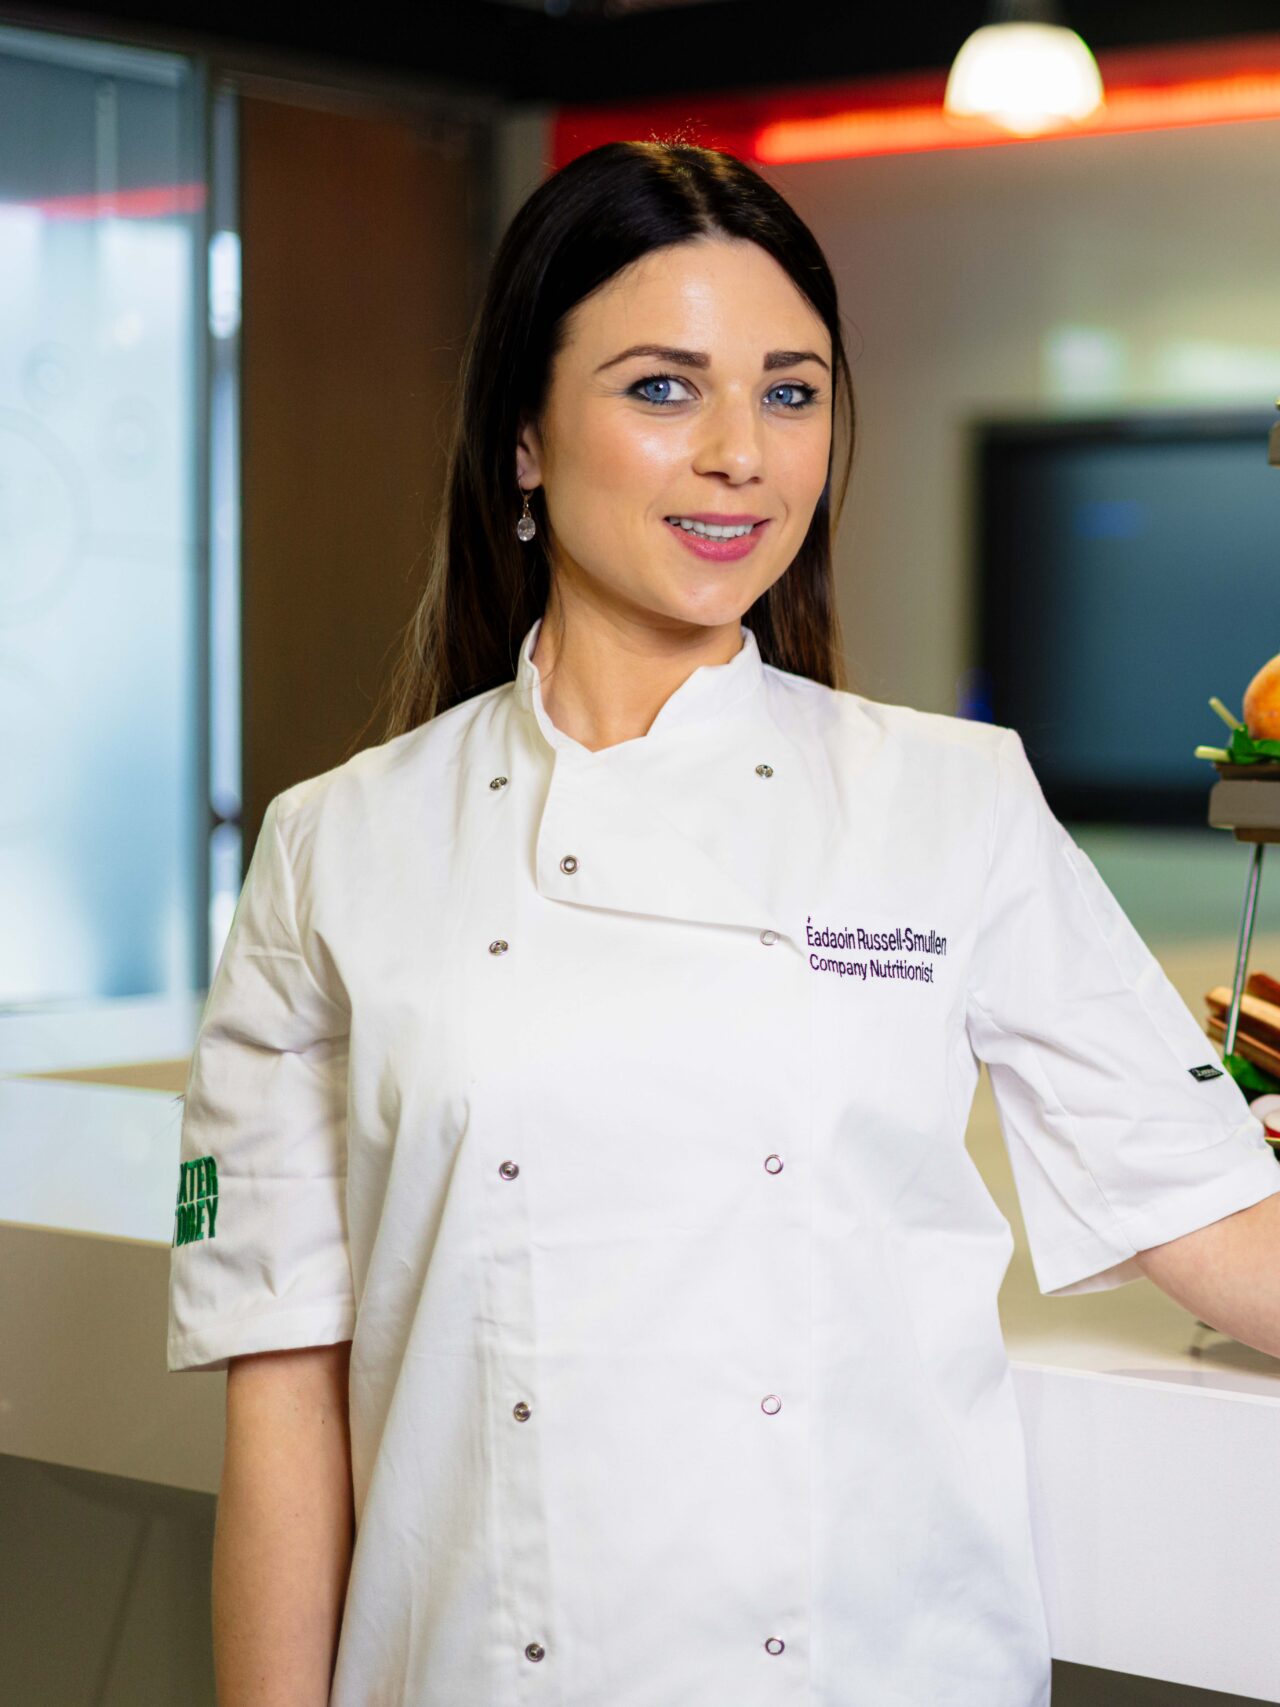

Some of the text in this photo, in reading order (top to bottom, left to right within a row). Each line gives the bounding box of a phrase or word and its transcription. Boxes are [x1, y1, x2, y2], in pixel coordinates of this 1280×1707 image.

[806, 916, 947, 956] Éadaoin Russell-Smullen
[809, 953, 934, 984] Company Nutritionist
